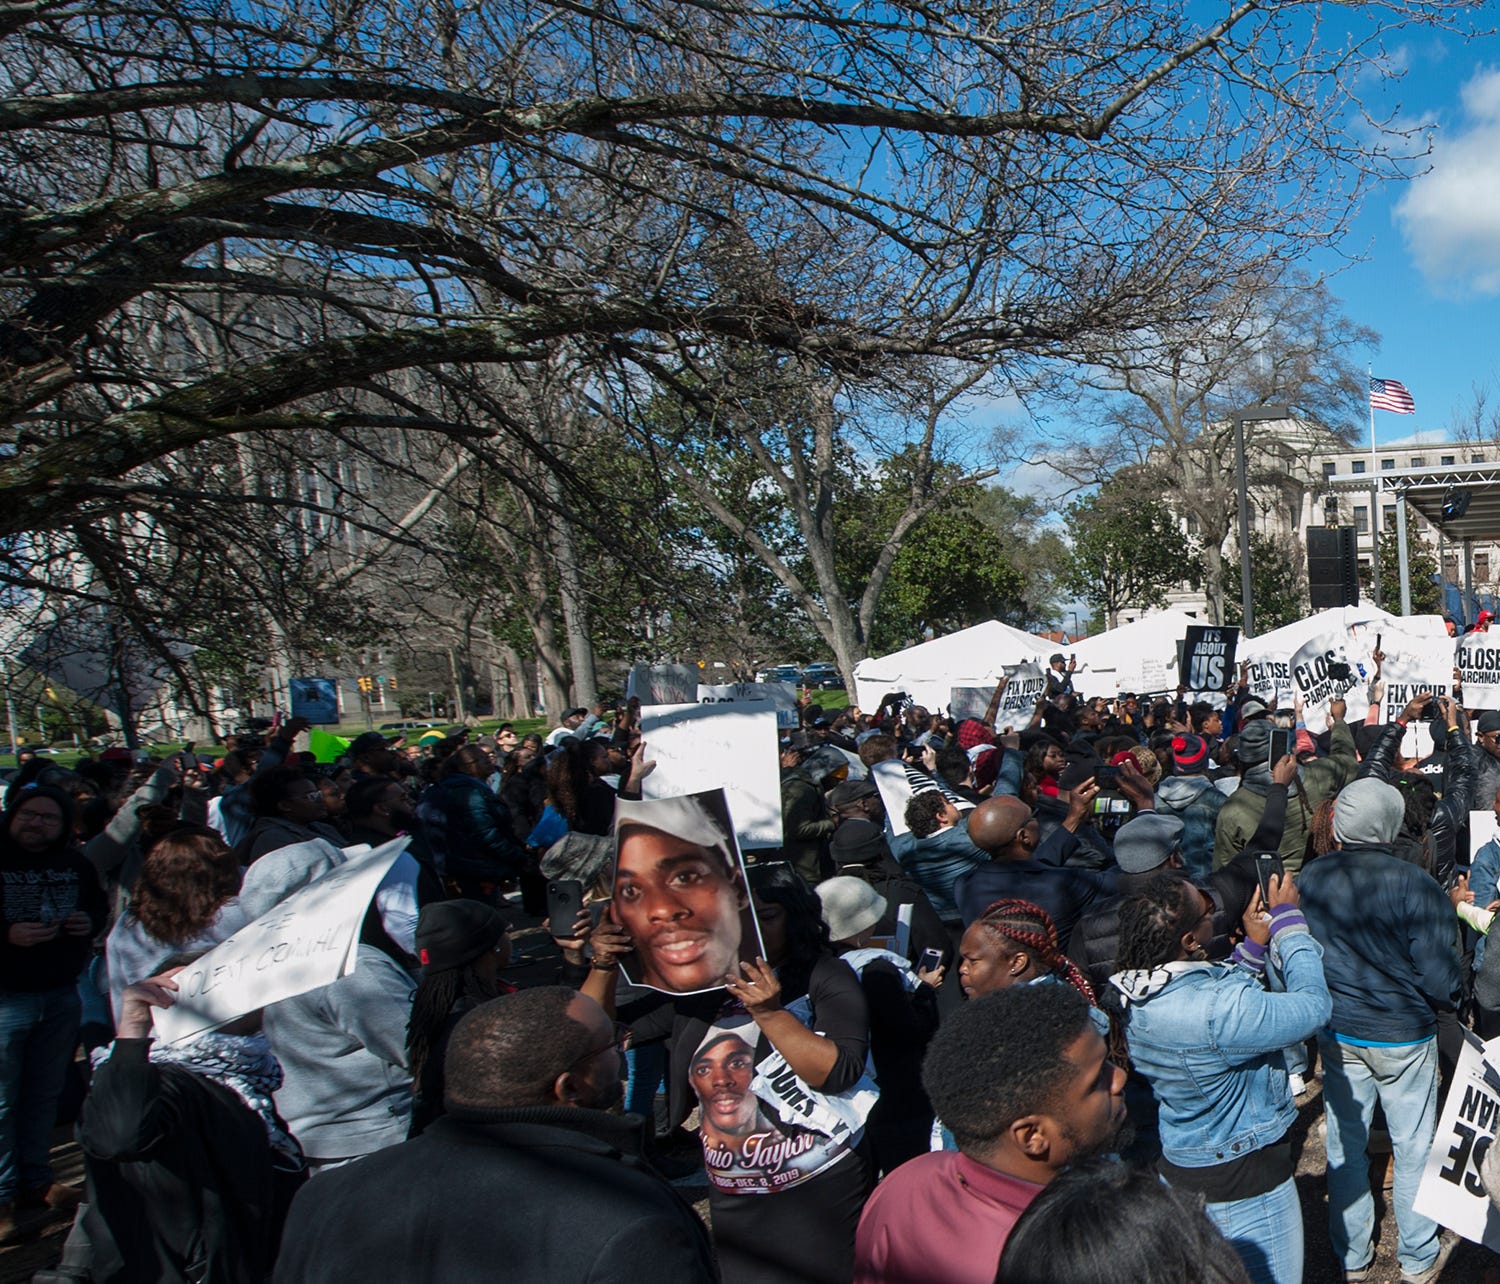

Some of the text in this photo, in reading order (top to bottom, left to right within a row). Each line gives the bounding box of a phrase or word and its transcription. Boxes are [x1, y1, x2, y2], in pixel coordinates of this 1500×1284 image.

[1203, 629, 1222, 642] IT'S
[1194, 642, 1227, 656] ABOUT
[1190, 655, 1225, 690] US
[1006, 680, 1020, 696] FIX
[1387, 684, 1409, 704] FIX
